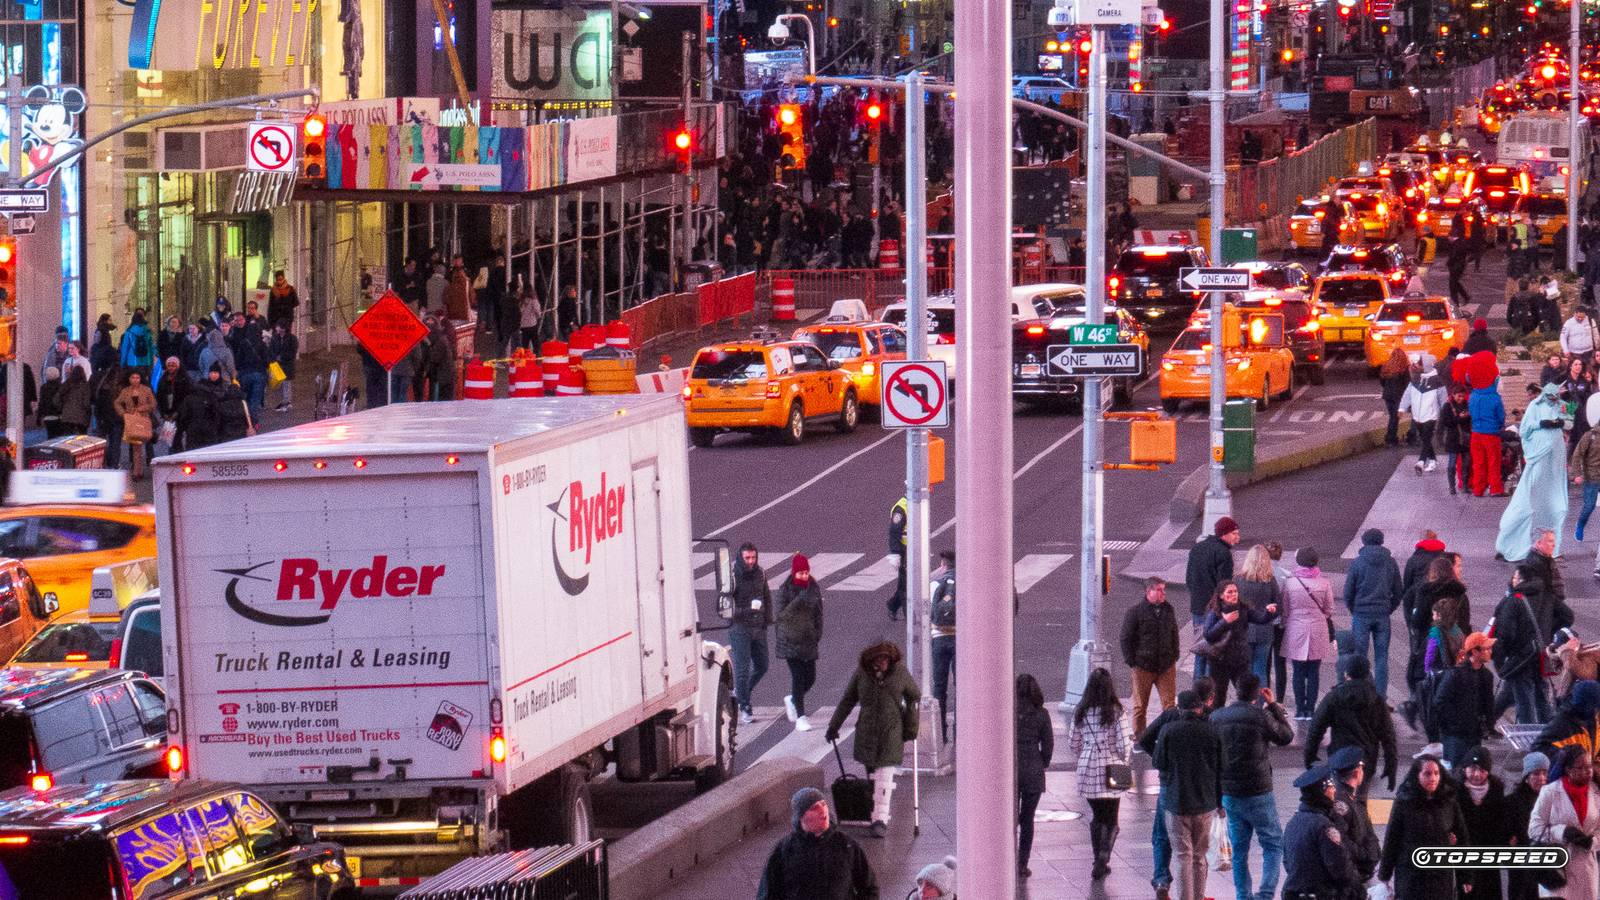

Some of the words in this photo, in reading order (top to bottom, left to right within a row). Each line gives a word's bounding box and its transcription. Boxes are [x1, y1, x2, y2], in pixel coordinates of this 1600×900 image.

[1097, 8, 1121, 17] CAMERA
[21, 196, 41, 205] WAY
[1201, 275, 1219, 284] ONE
[1223, 275, 1241, 284] WAY
[1073, 327, 1085, 342] W
[1060, 355, 1088, 367] ONE
[1103, 355, 1131, 366] WAY
[212, 464, 249, 478] 585595
[570, 471, 626, 566] Ryder
[276, 555, 446, 610] Ryder
[214, 653, 269, 673] Truck
[276, 650, 343, 671] Rental
[350, 649, 366, 668] &
[372, 647, 451, 670] Leasing
[513, 693, 529, 724] Truck
[530, 682, 550, 715] Rental
[557, 672, 577, 702] Leasing
[246, 700, 339, 714] 1-800-BY-RYDER
[246, 717, 340, 731] www.ryder.com
[247, 734, 271, 748] Buy
[274, 733, 292, 745] the
[296, 731, 324, 744] Best
[326, 730, 357, 743] Used
[360, 729, 400, 742] Trucks
[428, 727, 460, 750] READY
[248, 746, 362, 759] www.usedtrucks.ryder.com
